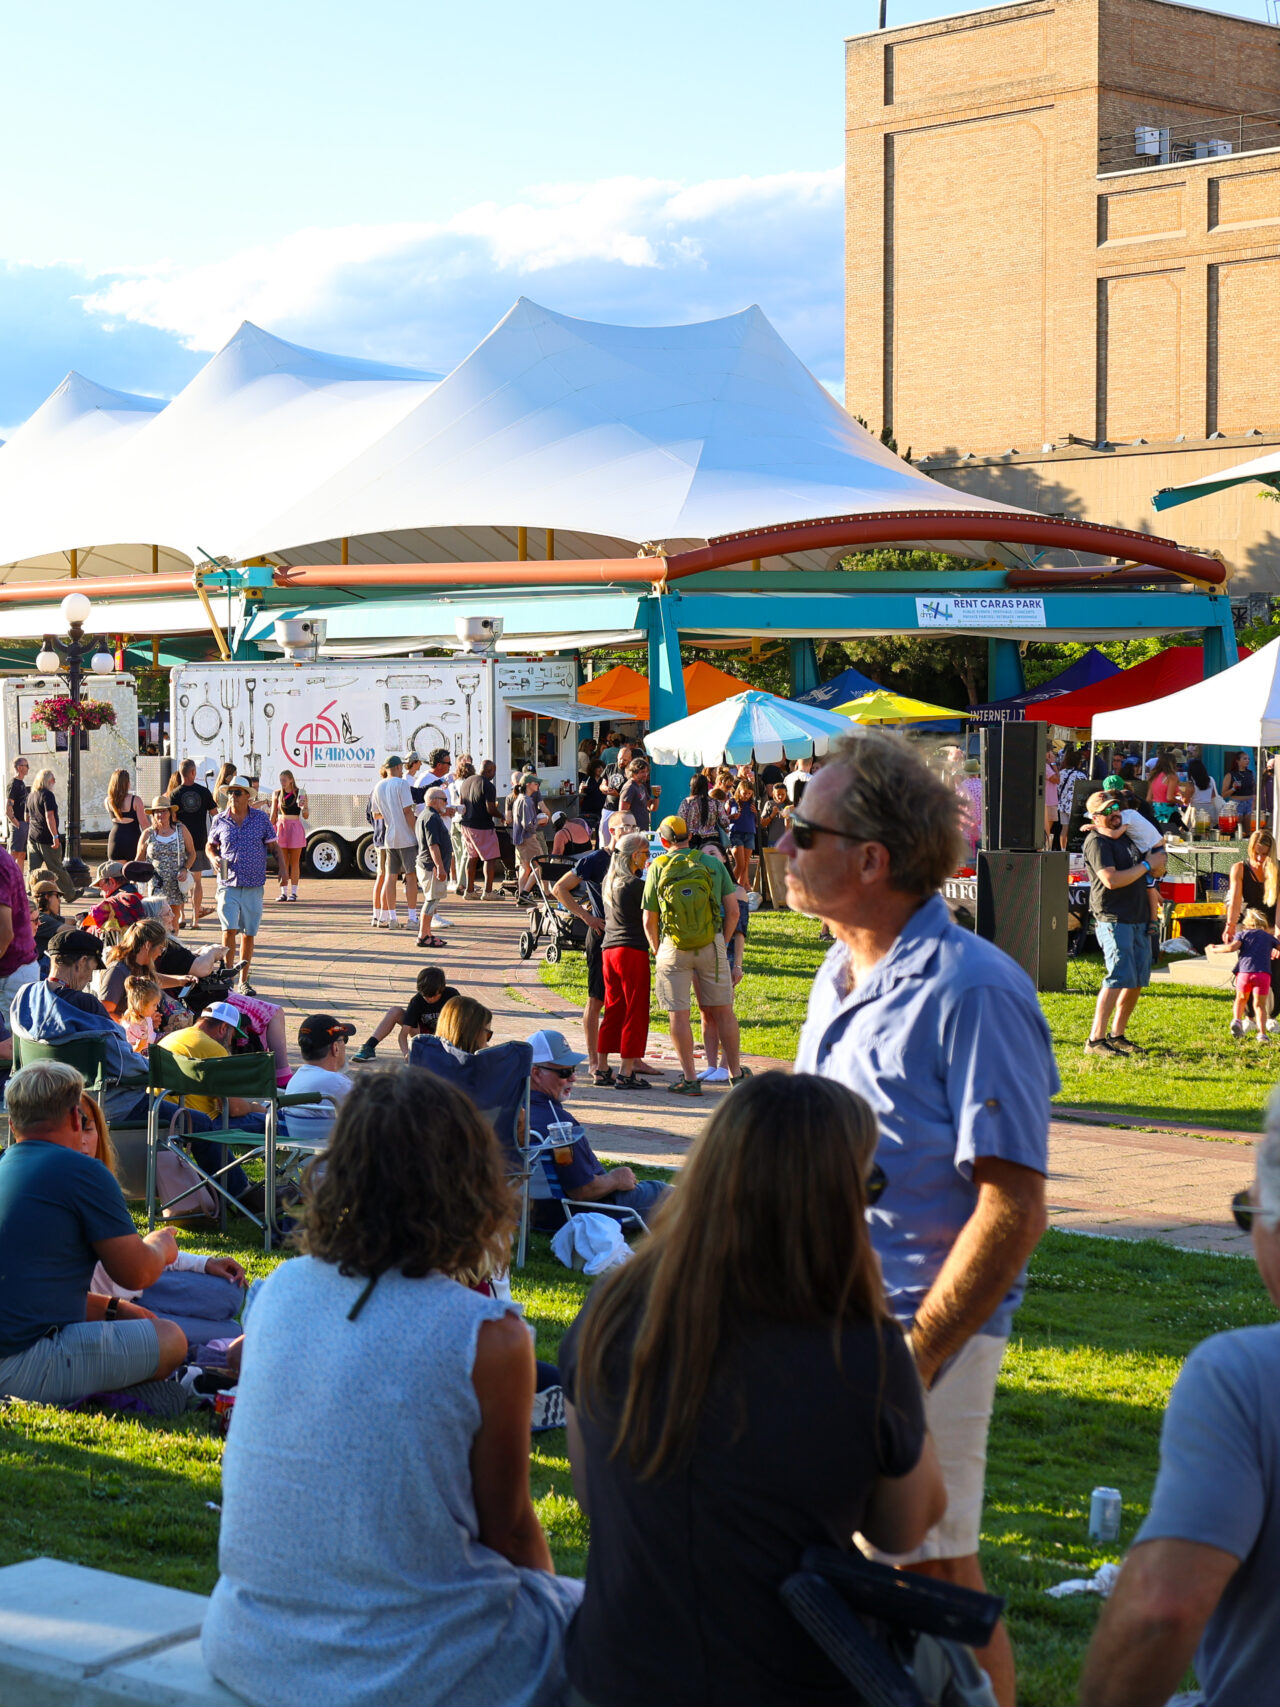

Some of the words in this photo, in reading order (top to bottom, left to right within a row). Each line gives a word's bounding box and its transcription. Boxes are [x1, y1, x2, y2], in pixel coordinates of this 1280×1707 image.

[953, 600, 978, 608] RENT
[980, 600, 1014, 608] CARAS
[1016, 600, 1042, 608] PARK
[970, 709, 1010, 721] INTERNET
